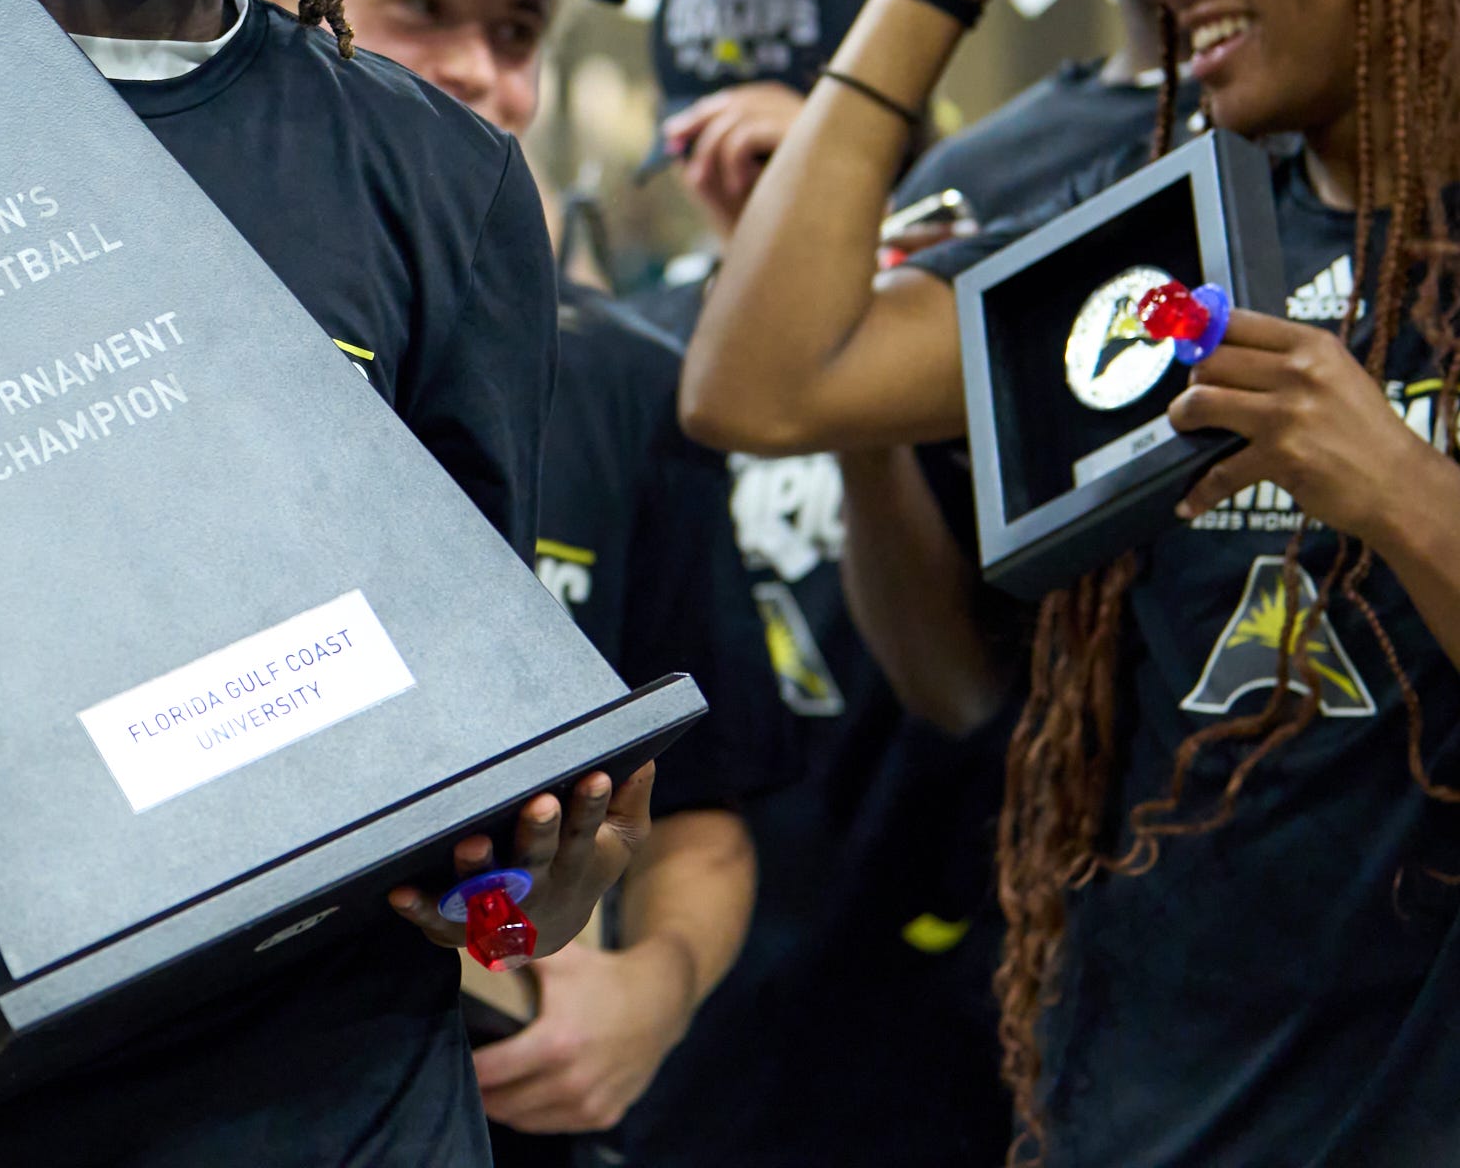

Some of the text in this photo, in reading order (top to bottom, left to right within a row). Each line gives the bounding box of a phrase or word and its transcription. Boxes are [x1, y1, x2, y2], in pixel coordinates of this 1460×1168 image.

[128, 629, 353, 744] FLORIDA GULF COAST
[195, 680, 322, 750] UNIVERSITY
